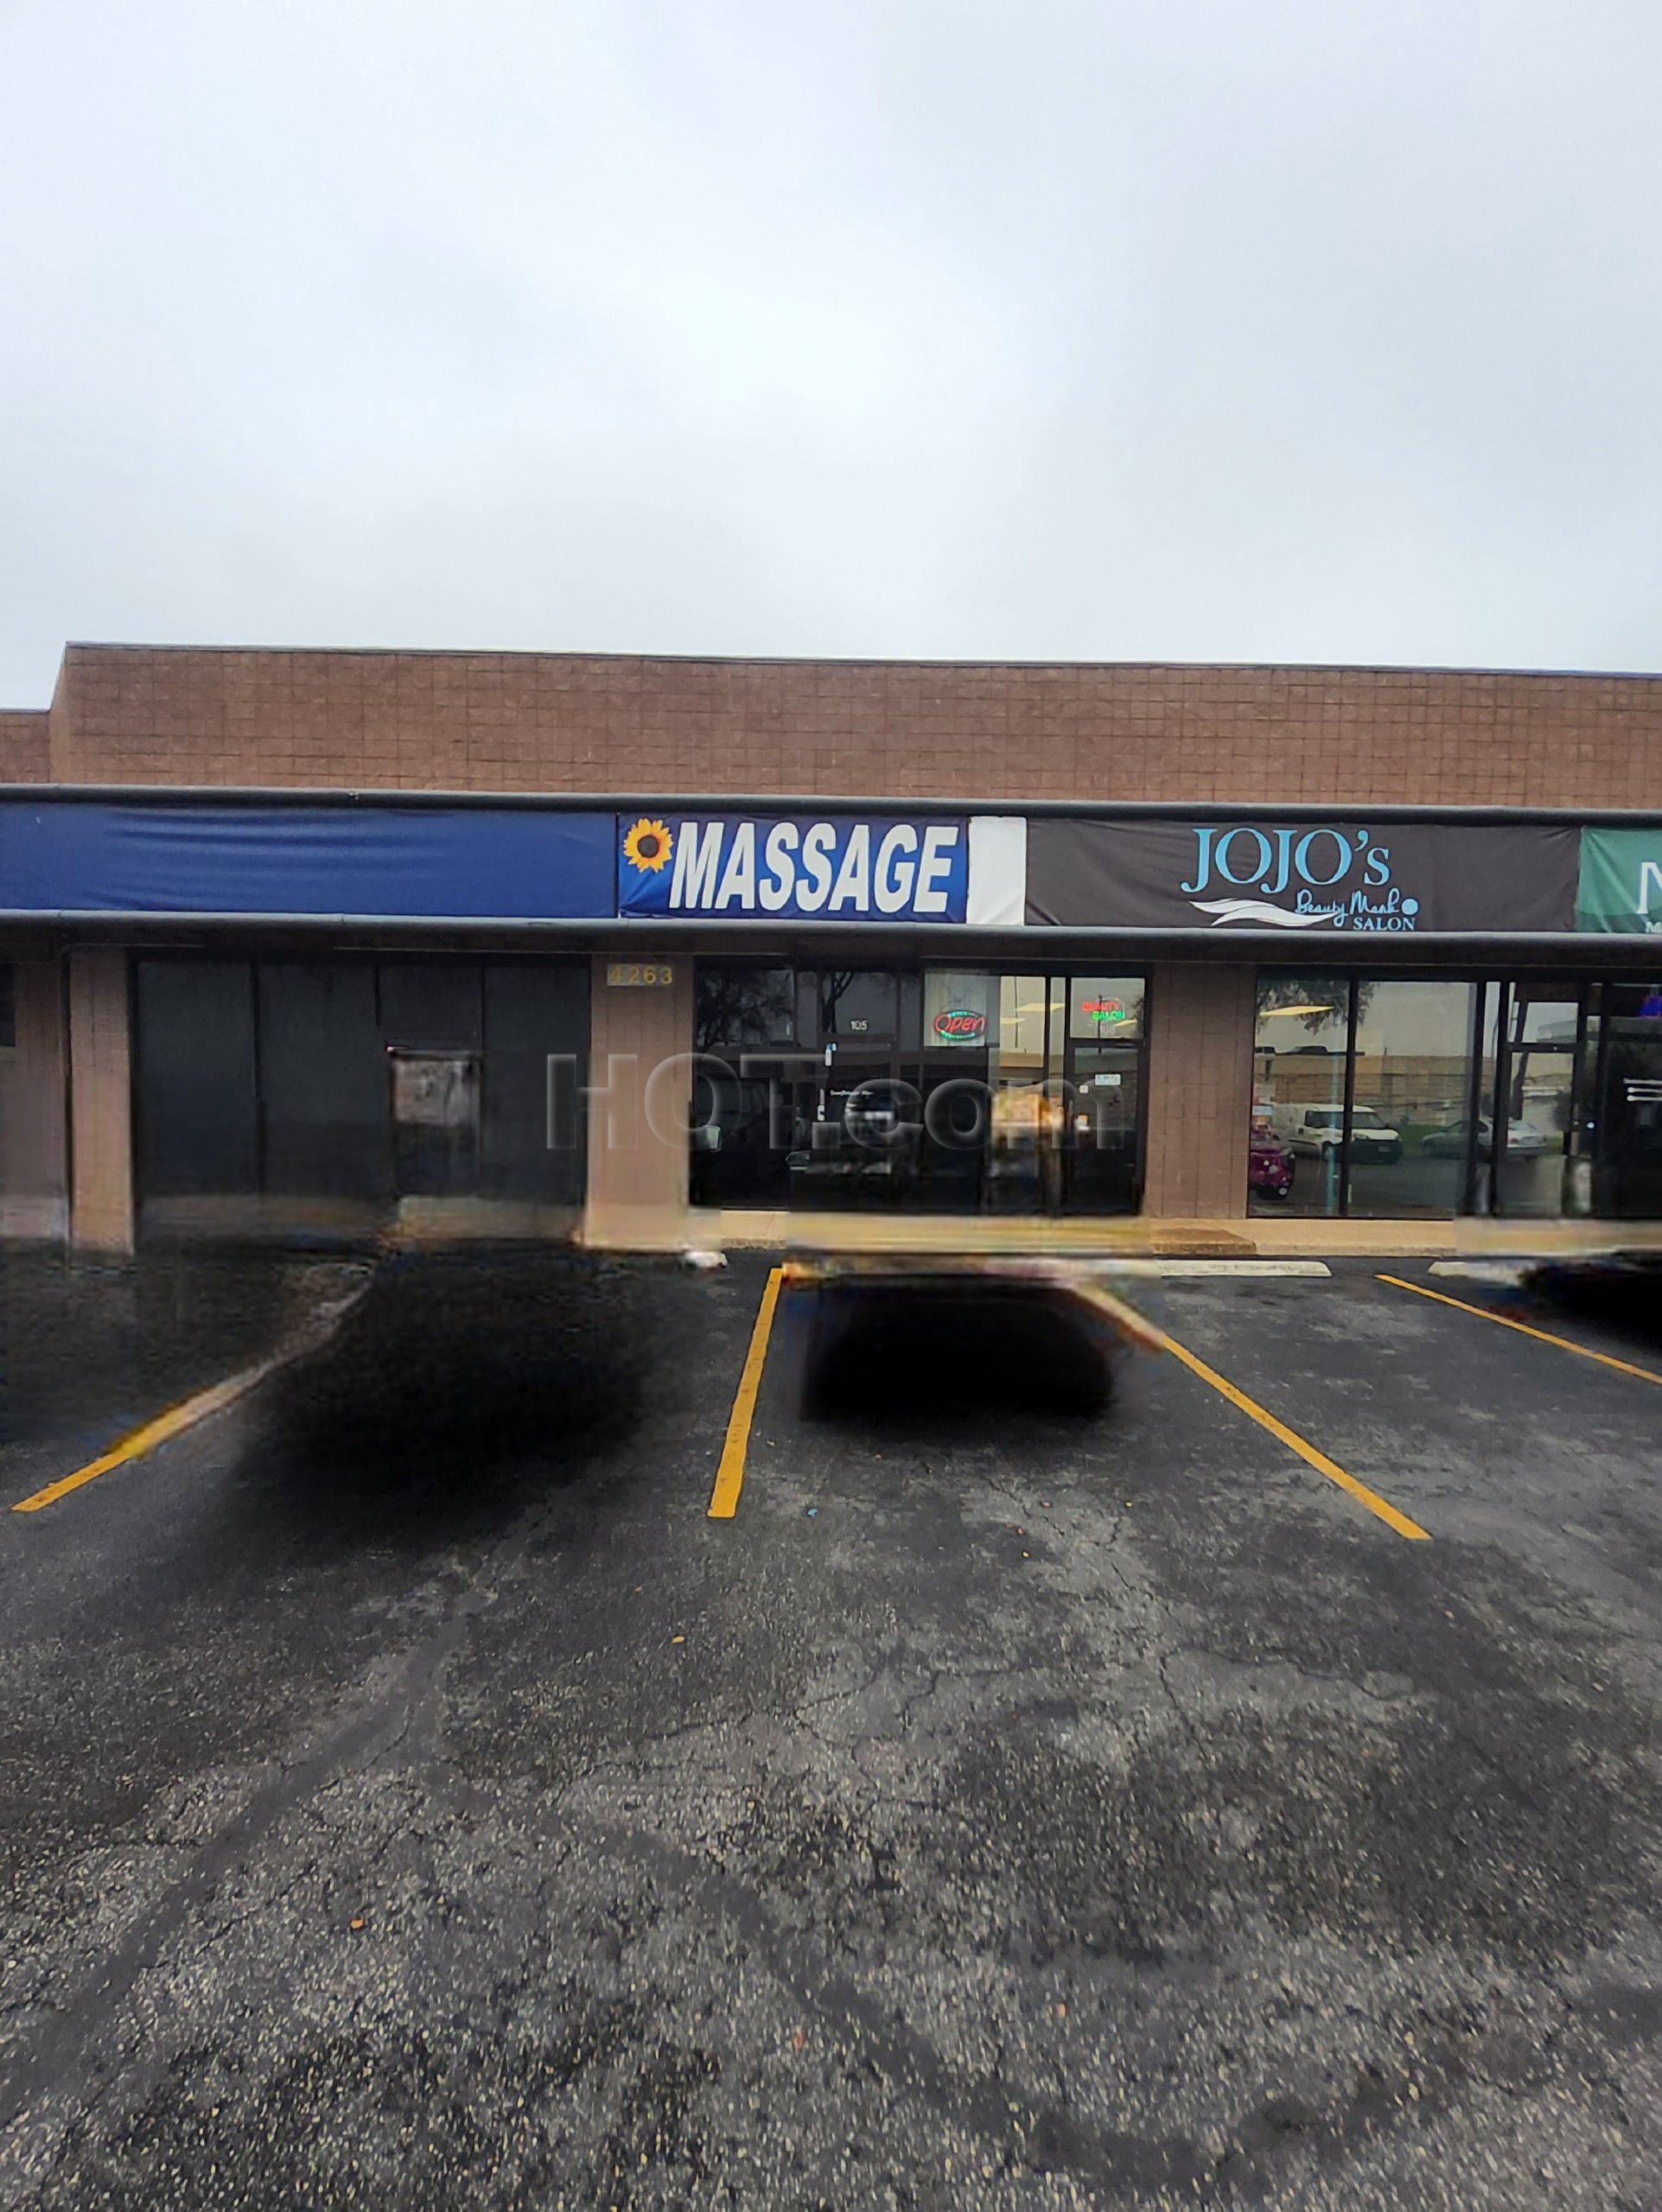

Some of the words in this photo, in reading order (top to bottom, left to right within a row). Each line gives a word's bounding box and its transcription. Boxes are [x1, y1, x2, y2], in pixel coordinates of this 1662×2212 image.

[669, 822, 958, 912] MASSAGE
[1295, 888, 1348, 927] Beauty
[1349, 887, 1400, 915] Mark
[1353, 917, 1415, 931] SALON
[608, 965, 672, 984] 4263
[850, 1020, 868, 1030] 105
